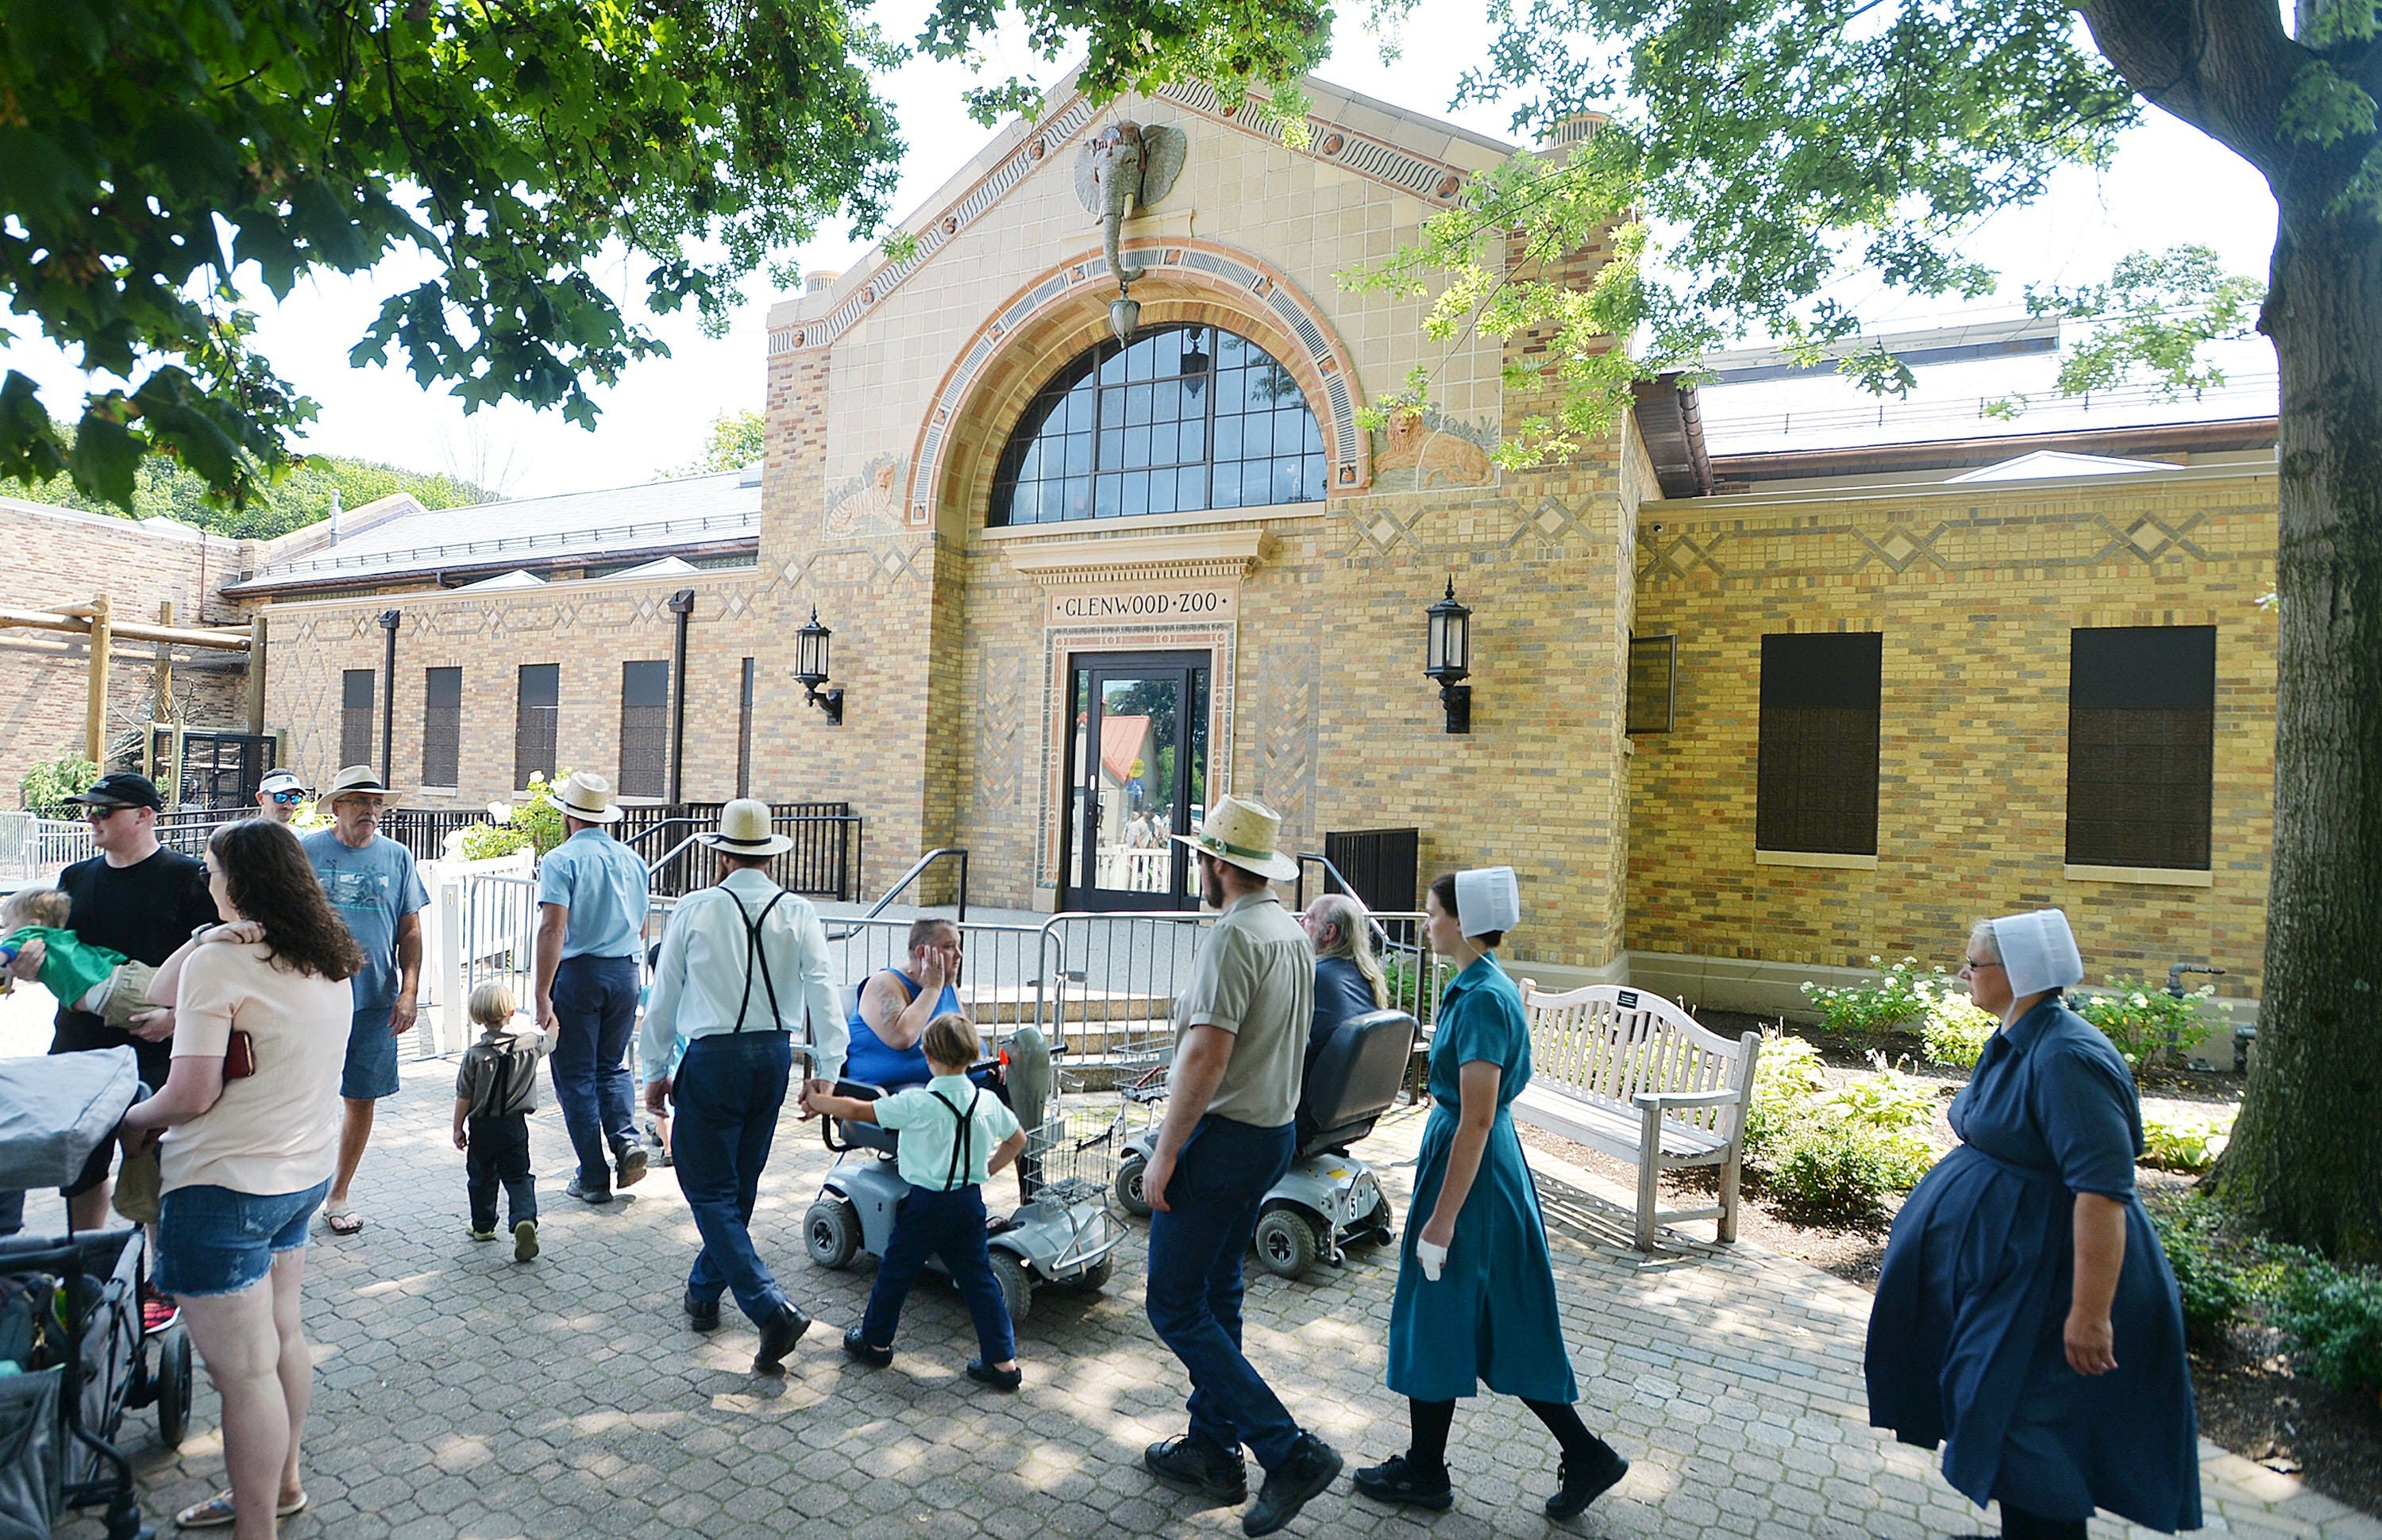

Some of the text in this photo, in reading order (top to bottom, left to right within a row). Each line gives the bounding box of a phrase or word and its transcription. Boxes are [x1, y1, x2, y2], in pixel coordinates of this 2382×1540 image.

[1065, 592, 1217, 616] GLENWOOD ZOO
[1351, 1197, 1356, 1218] 5
